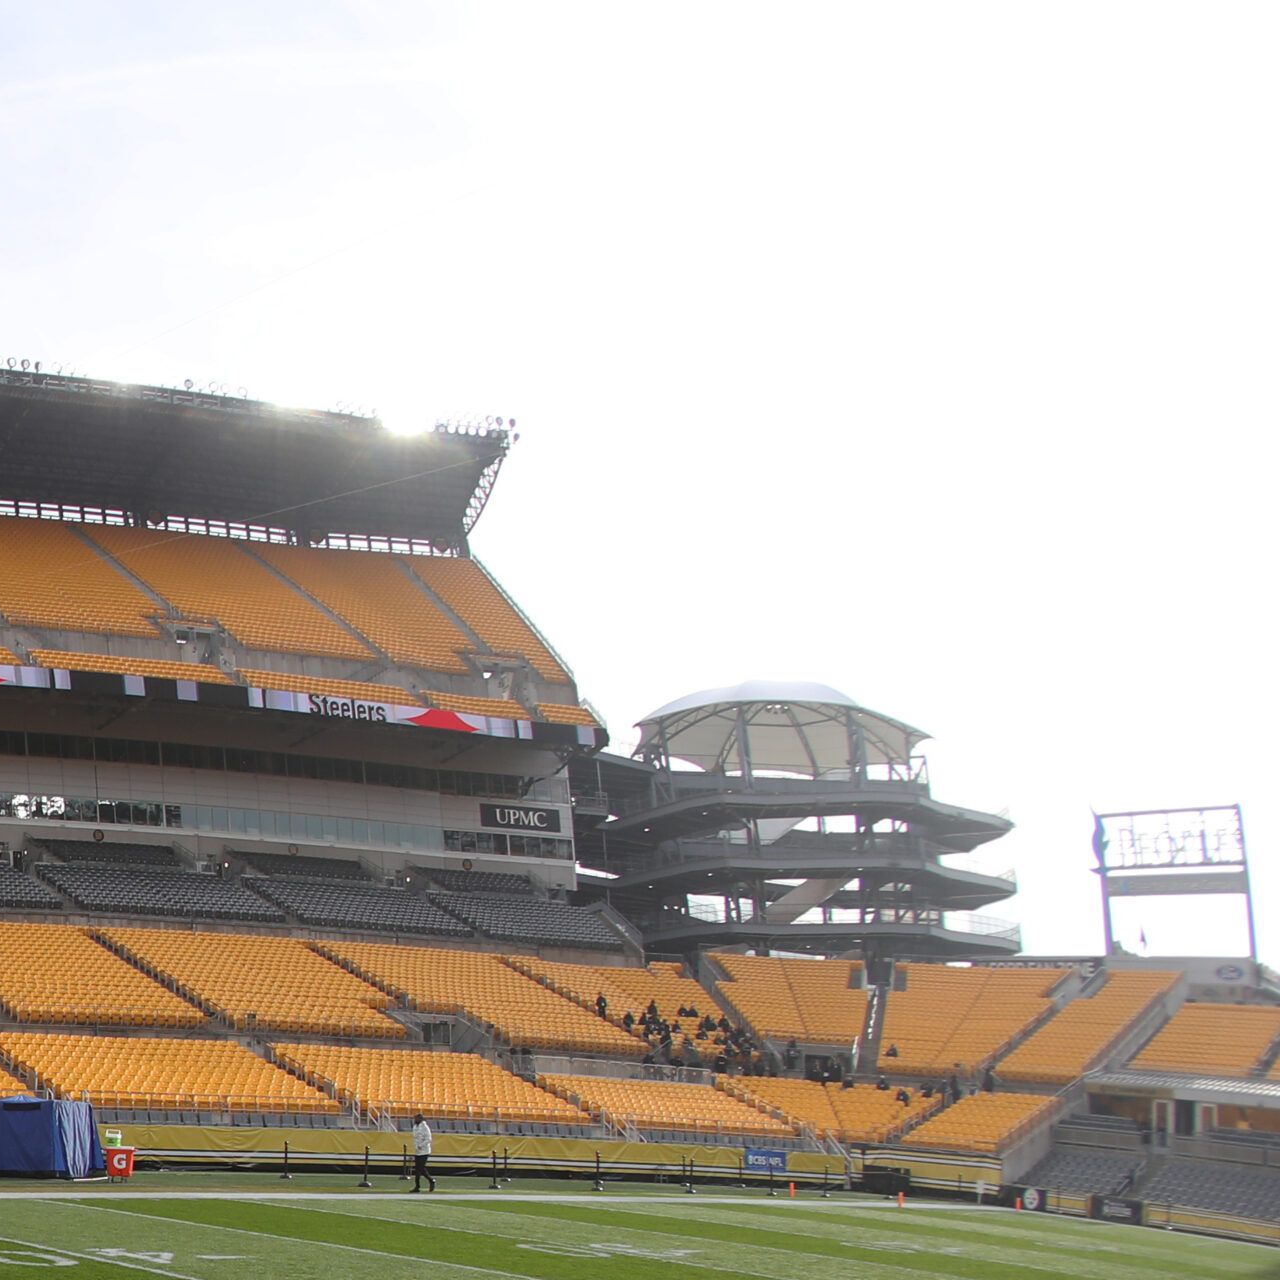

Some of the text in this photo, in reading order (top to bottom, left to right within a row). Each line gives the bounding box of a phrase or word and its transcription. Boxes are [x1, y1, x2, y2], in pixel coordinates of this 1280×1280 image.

[308, 693, 387, 722] Steelers
[495, 808, 549, 828] UPMC
[113, 1153, 127, 1169] G
